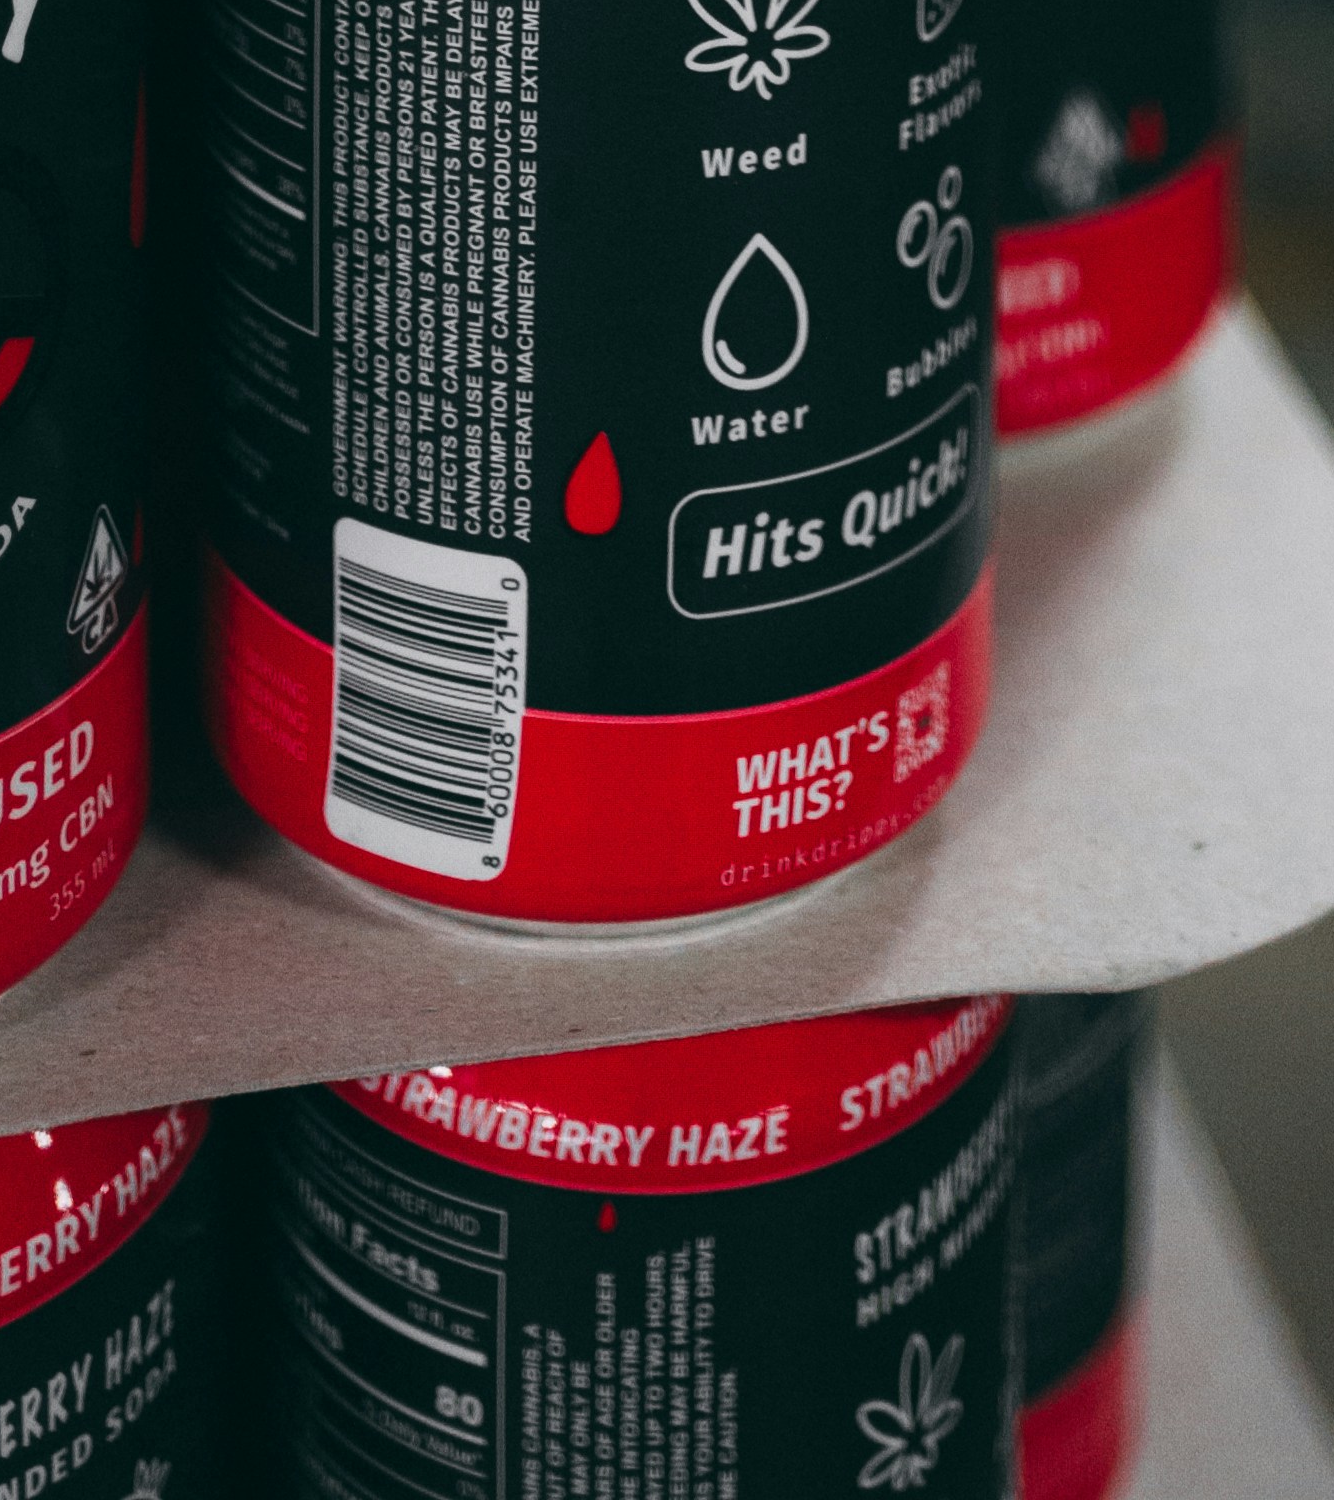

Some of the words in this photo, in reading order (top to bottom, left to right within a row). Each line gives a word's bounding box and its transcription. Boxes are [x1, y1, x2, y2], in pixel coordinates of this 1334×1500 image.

[445, 70, 462, 99] BE
[496, 6, 513, 94] IMPAIRS
[521, 0, 539, 103] EXTREME
[909, 48, 978, 106] Exotic
[444, 105, 462, 151] MAY
[469, 136, 486, 169] OR
[493, 100, 512, 221] PRODUCTS
[519, 110, 537, 153] USE
[700, 134, 808, 180] Weed
[443, 157, 460, 276] PRODUCTS
[467, 174, 485, 295] PREGNANT
[519, 160, 537, 245] PLEASE
[492, 227, 510, 339] CANNABIS
[516, 253, 535, 383] MACHINERY.
[442, 282, 459, 394] CANNABIS
[466, 300, 484, 369] WHILE
[491, 345, 508, 375] OF
[886, 317, 979, 398] Bubbles
[441, 399, 458, 429] OF
[465, 375, 482, 418] USE
[691, 403, 810, 444] Water
[464, 424, 482, 536] CANNABIS
[489, 381, 508, 539] CONSUMPTION
[515, 390, 533, 490] OPERATE
[441, 435, 458, 531] EFFECTS
[514, 497, 531, 543] AND
[701, 511, 824, 579] Hits
[840, 431, 969, 549] Quick!
[734, 709, 891, 795] WHAT'S
[56, 774, 116, 851] CBN
[732, 772, 853, 839] THIS?
[114, 1116, 188, 1217] HAZE
[667, 1109, 790, 1166] HAZE
[351, 1222, 438, 1292] Facts
[104, 1280, 179, 1397] HAZE
[436, 1386, 484, 1425] 80
